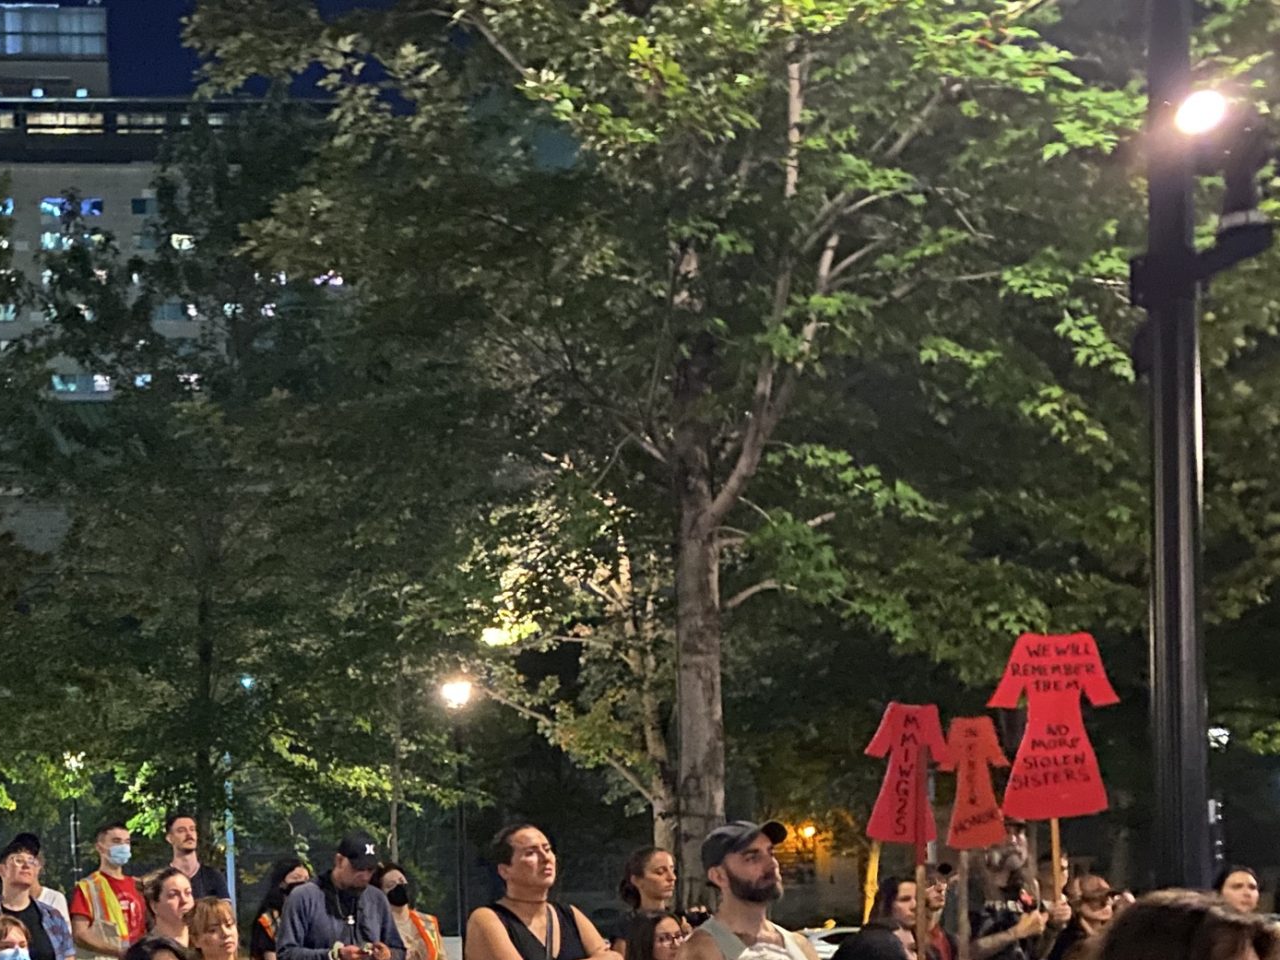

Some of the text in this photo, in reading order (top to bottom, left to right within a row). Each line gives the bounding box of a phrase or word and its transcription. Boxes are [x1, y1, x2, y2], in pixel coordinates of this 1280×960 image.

[1025, 643, 1090, 658] WE WILL
[1011, 662, 1095, 677] REMEMBER
[1046, 723, 1070, 736] NO
[1031, 736, 1081, 751] MORE
[1023, 751, 1086, 770] STOLEN
[1011, 768, 1091, 791] SISTERS
